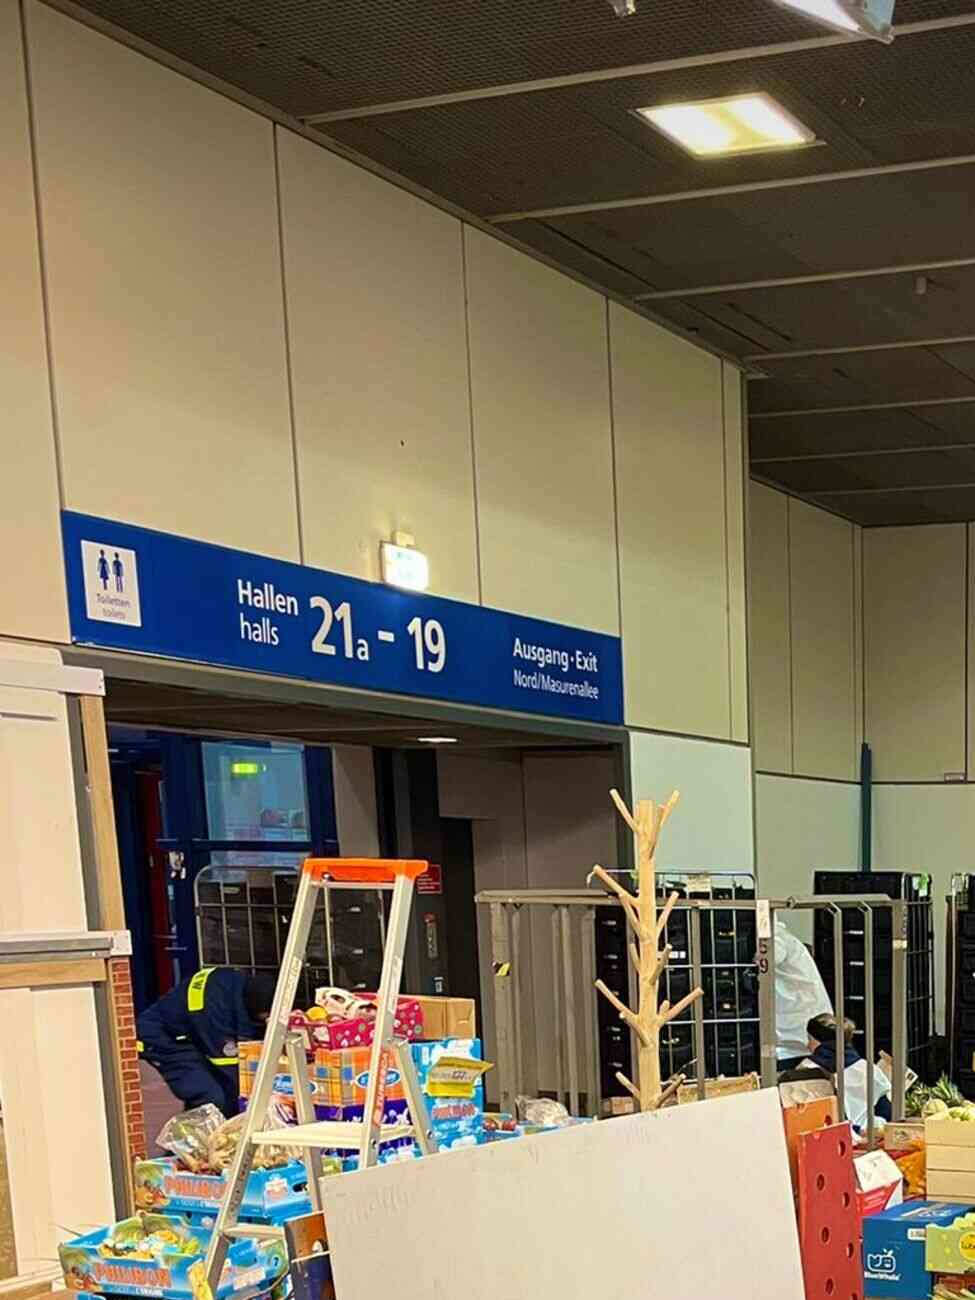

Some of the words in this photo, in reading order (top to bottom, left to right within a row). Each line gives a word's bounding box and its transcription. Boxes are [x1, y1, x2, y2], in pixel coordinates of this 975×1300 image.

[237, 578, 299, 616] Hallen
[309, 595, 370, 662] 21a
[407, 616, 447, 673] 19
[239, 612, 280, 646] halls
[512, 669, 600, 700] Nord/Masurenallee
